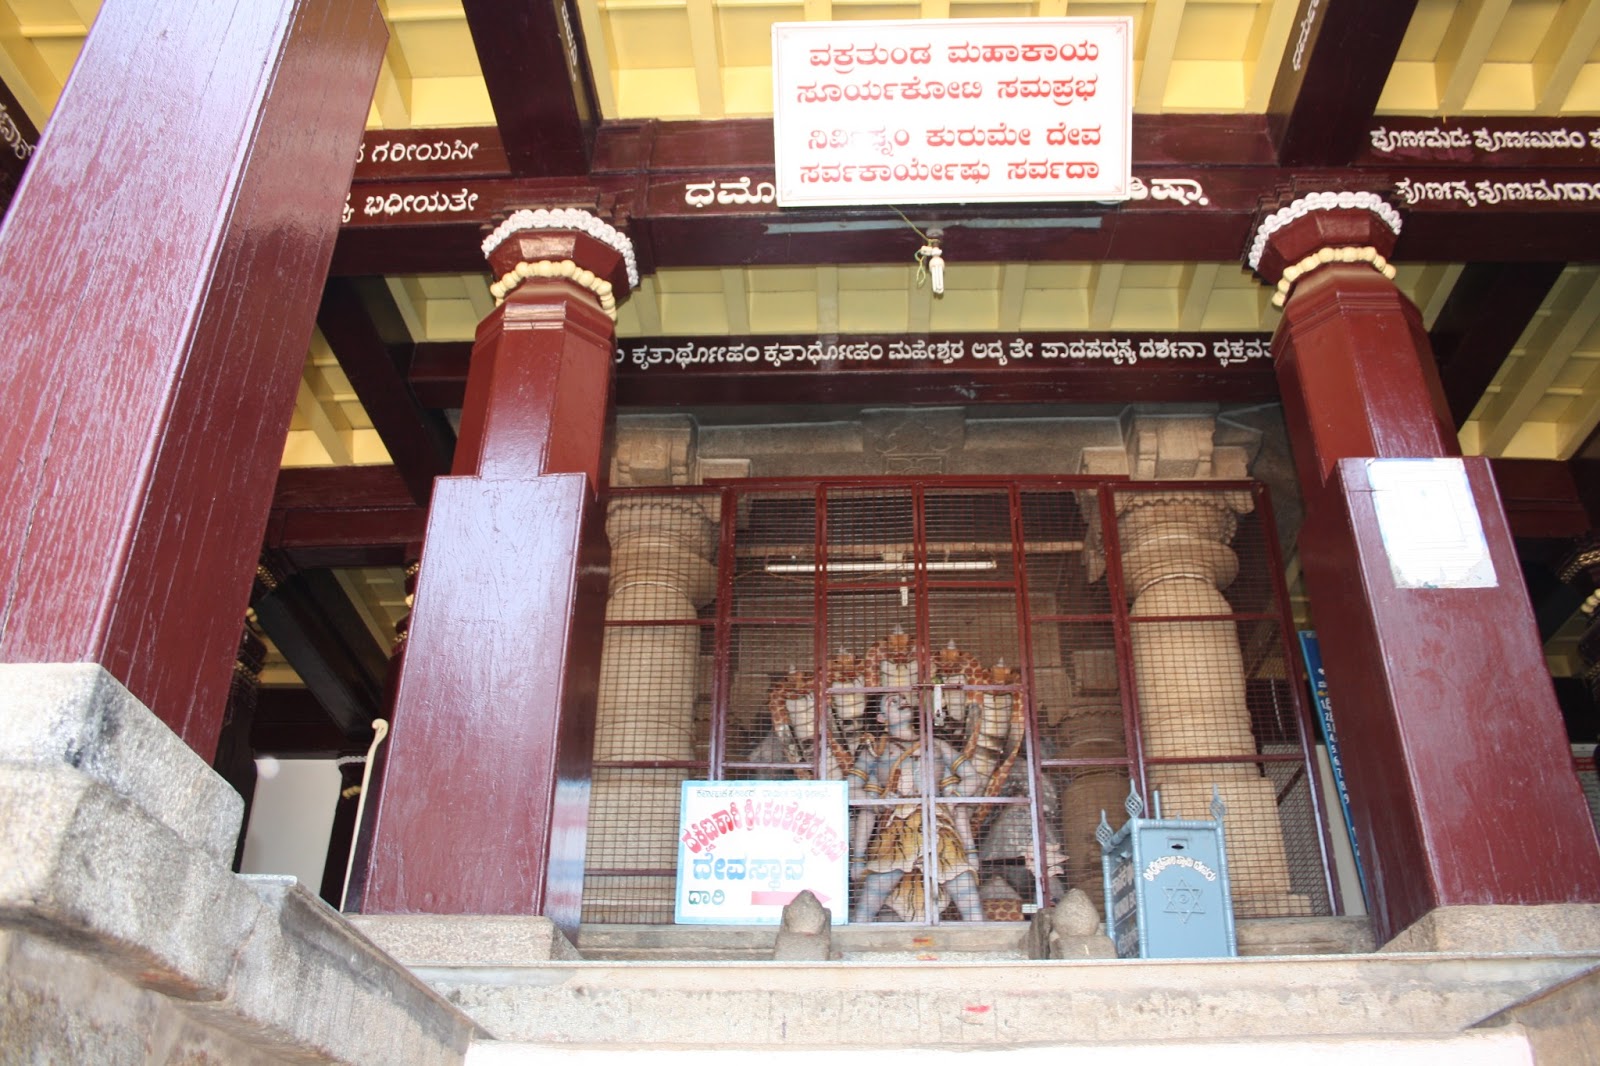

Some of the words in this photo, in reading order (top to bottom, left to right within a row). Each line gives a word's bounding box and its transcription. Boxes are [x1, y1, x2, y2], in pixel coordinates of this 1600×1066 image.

[810, 41, 931, 74] ವಕ್ರತುಂಡ
[947, 39, 1099, 66] ಮಹಾಕಾಯ
[797, 76, 982, 103] ಸೂರ್ಯಕೋಟಿ
[998, 73, 1098, 106] ಸಮಪ್ರಭ
[926, 122, 1031, 147] ಕುರುಮೇ
[1046, 122, 1101, 147] ದೇವ
[1370, 126, 1472, 152] ಪೂರ್ಣಮದಃ
[371, 139, 479, 163] ಗರೀಯಸೀ
[800, 157, 990, 185] ಸರ್ವಕಾರ್ಯೇಷು
[1007, 157, 1100, 182] ಸರ್ವದಾ
[888, 339, 965, 364] ಮಹೇಶ್ವರ
[971, 339, 1008, 365] ಅದ್ಯ
[1009, 338, 1034, 358] ತೇ
[744, 799, 761, 832] ಶ್ರೀ
[688, 889, 725, 906] ದಾರಿ
